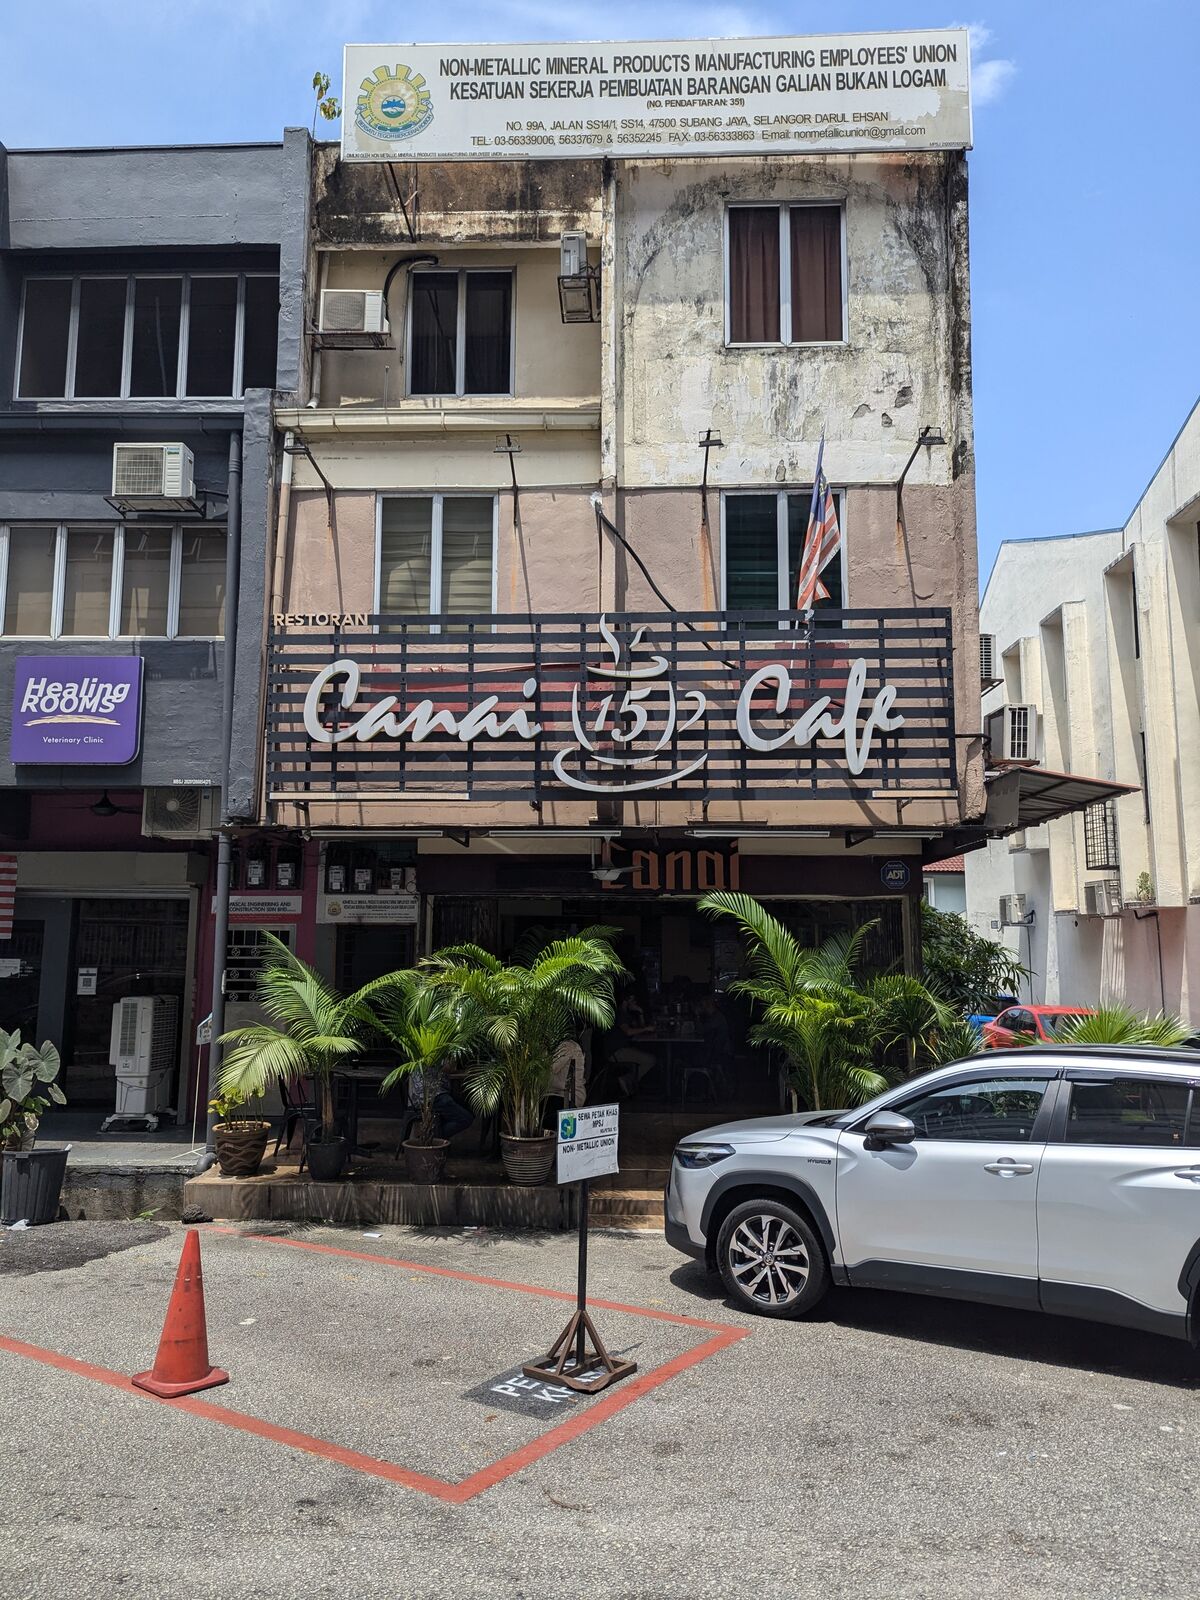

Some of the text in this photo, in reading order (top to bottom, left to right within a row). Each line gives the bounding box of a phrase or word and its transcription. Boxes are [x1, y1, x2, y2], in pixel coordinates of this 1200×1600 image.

[439, 44, 957, 77] NON-METALLIC MINERAL PRODUCTS MANUFACTURING EMPLOYEES' UNION
[450, 69, 946, 100] KESATUAN SEKERJA PEMBUATAN BARANGAN GALIAN BUKAN LOGAM
[646, 97, 745, 109] (NO. PENDAFTARAN: 351)
[506, 121, 523, 131] NO.
[525, 121, 546, 132] 99A,
[550, 120, 583, 131] JALAN
[620, 118, 645, 130] SS14,
[649, 118, 677, 129] 47500
[680, 117, 722, 128] SUBANG
[726, 116, 751, 127] JAYA,
[753, 114, 811, 126] SELANGOR
[815, 113, 849, 124] DARUL
[852, 112, 888, 122] EHSAN
[471, 136, 492, 147] TEL:
[558, 133, 603, 145] 56337679
[606, 133, 613, 144] &
[617, 132, 661, 144] 56352245
[668, 132, 691, 142] FAX:
[694, 131, 755, 142] 03-56333863
[273, 613, 369, 627] RESTORAN
[25, 677, 131, 703] Healing
[20, 694, 116, 713] ROOMS
[303, 657, 905, 776] Canai 15 Cafe
[43, 736, 104, 745] Veterinary Clinic
[886, 870, 905, 880] ADT
[577, 1112, 590, 1122] SEWA
[591, 1110, 605, 1120] PETAK
[605, 1108, 618, 1117] KHAS
[592, 1119, 604, 1128] MPSJ
[562, 1137, 615, 1154] NON- METALLIC UNION
